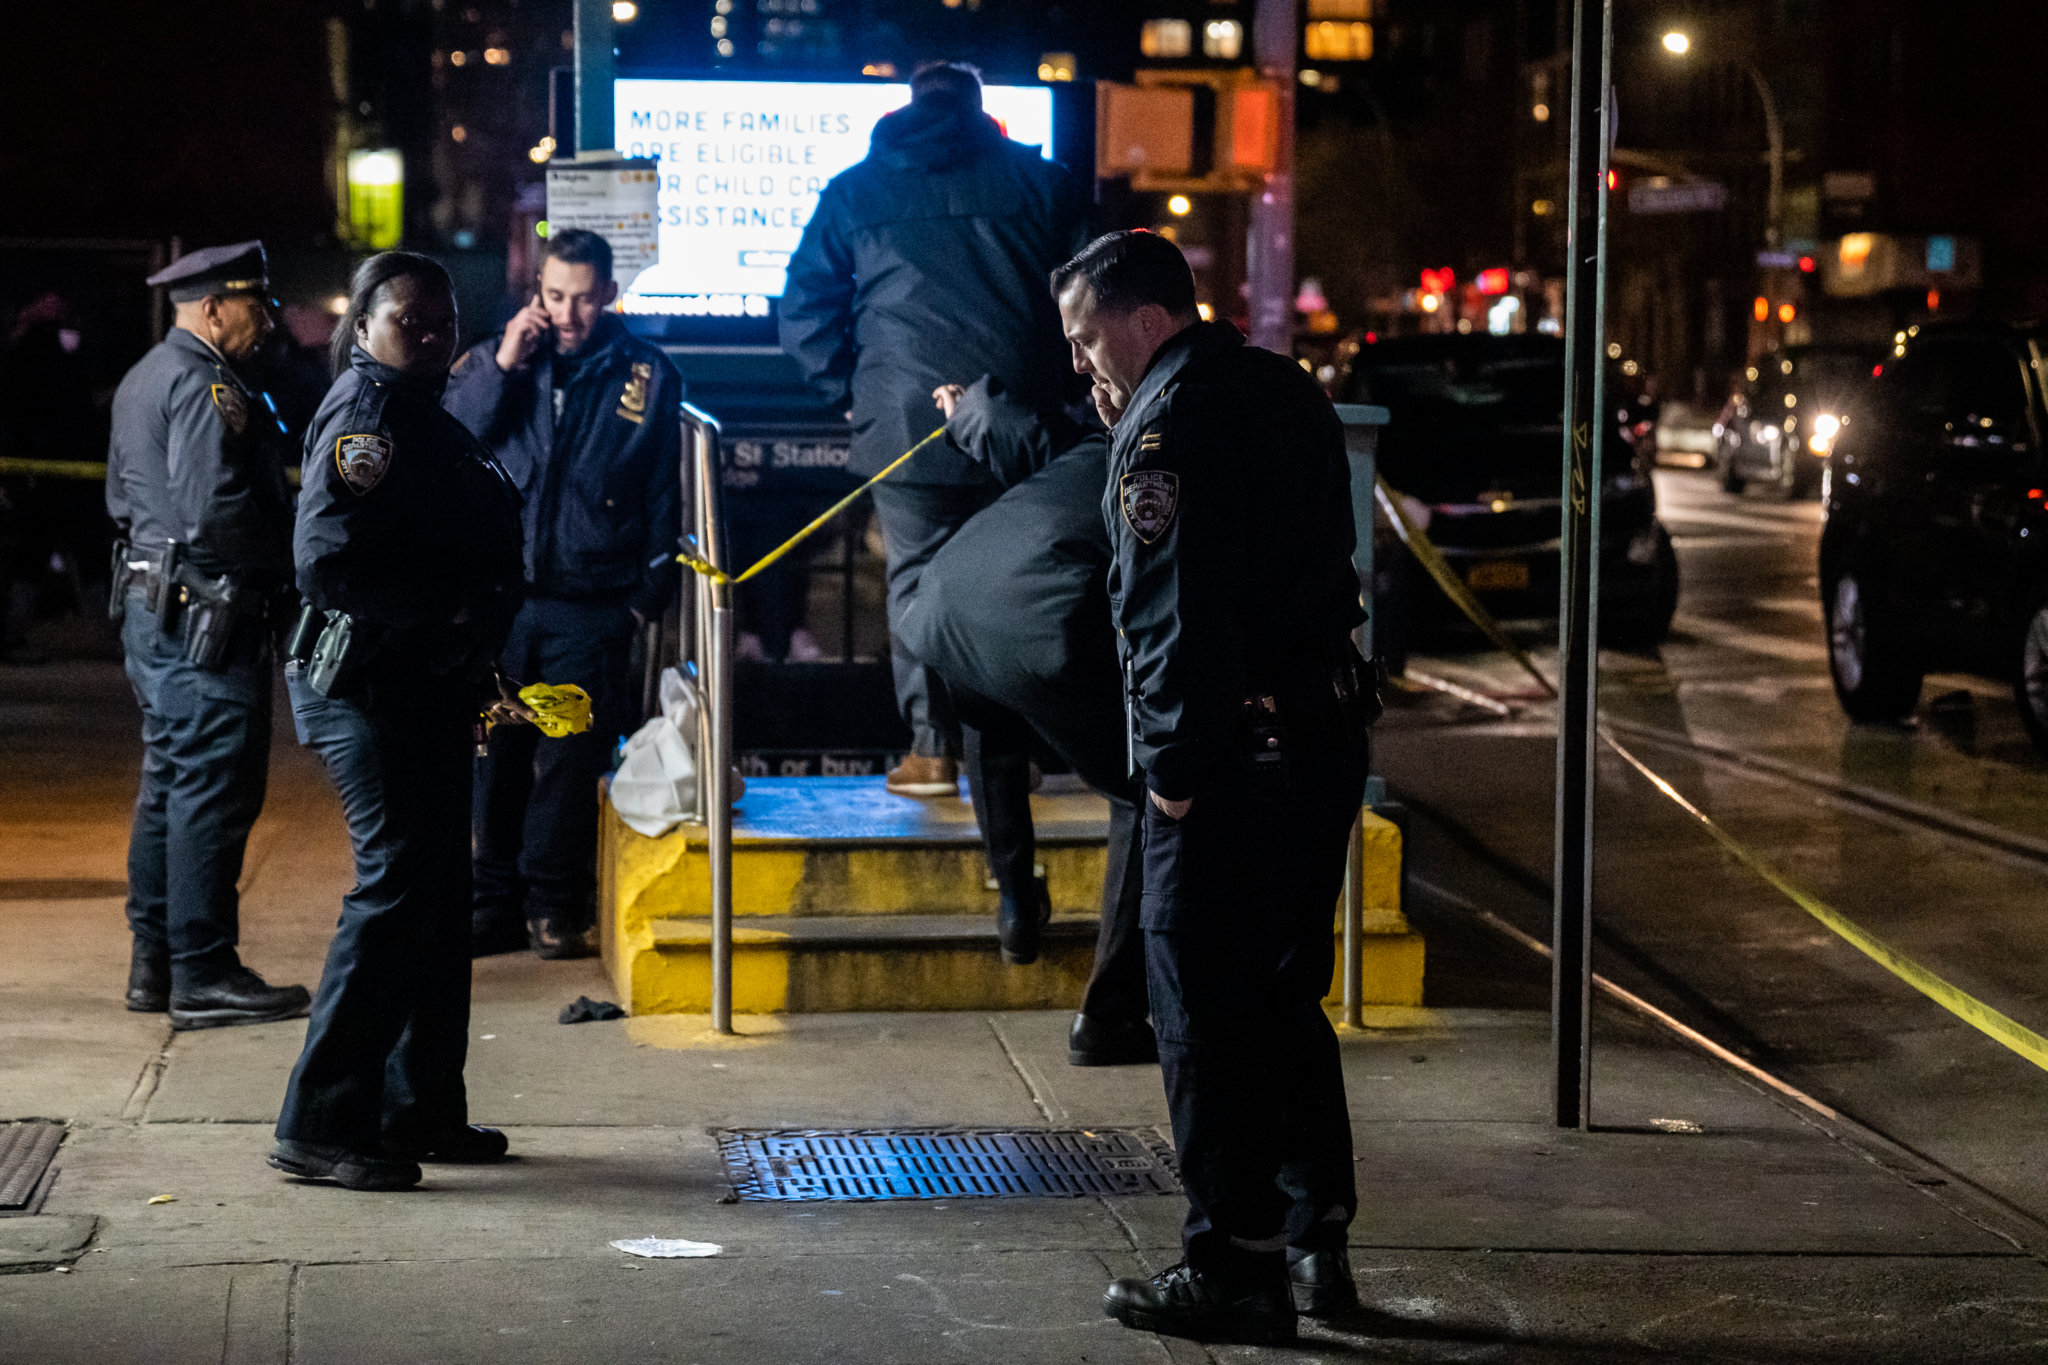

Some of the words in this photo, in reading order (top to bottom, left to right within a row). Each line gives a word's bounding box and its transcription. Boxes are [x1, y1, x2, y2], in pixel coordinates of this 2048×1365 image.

[630, 111, 708, 132] MORE
[723, 112, 850, 134] FAMILIES
[697, 143, 818, 165] ELIGIBLE
[696, 175, 774, 195] CHILD
[789, 176, 821, 197] CA
[657, 205, 803, 228] SISTANCE
[771, 441, 850, 467] Statio
[1124, 481, 1175, 497] DEPARTMENT
[1133, 474, 1164, 483] POLICE
